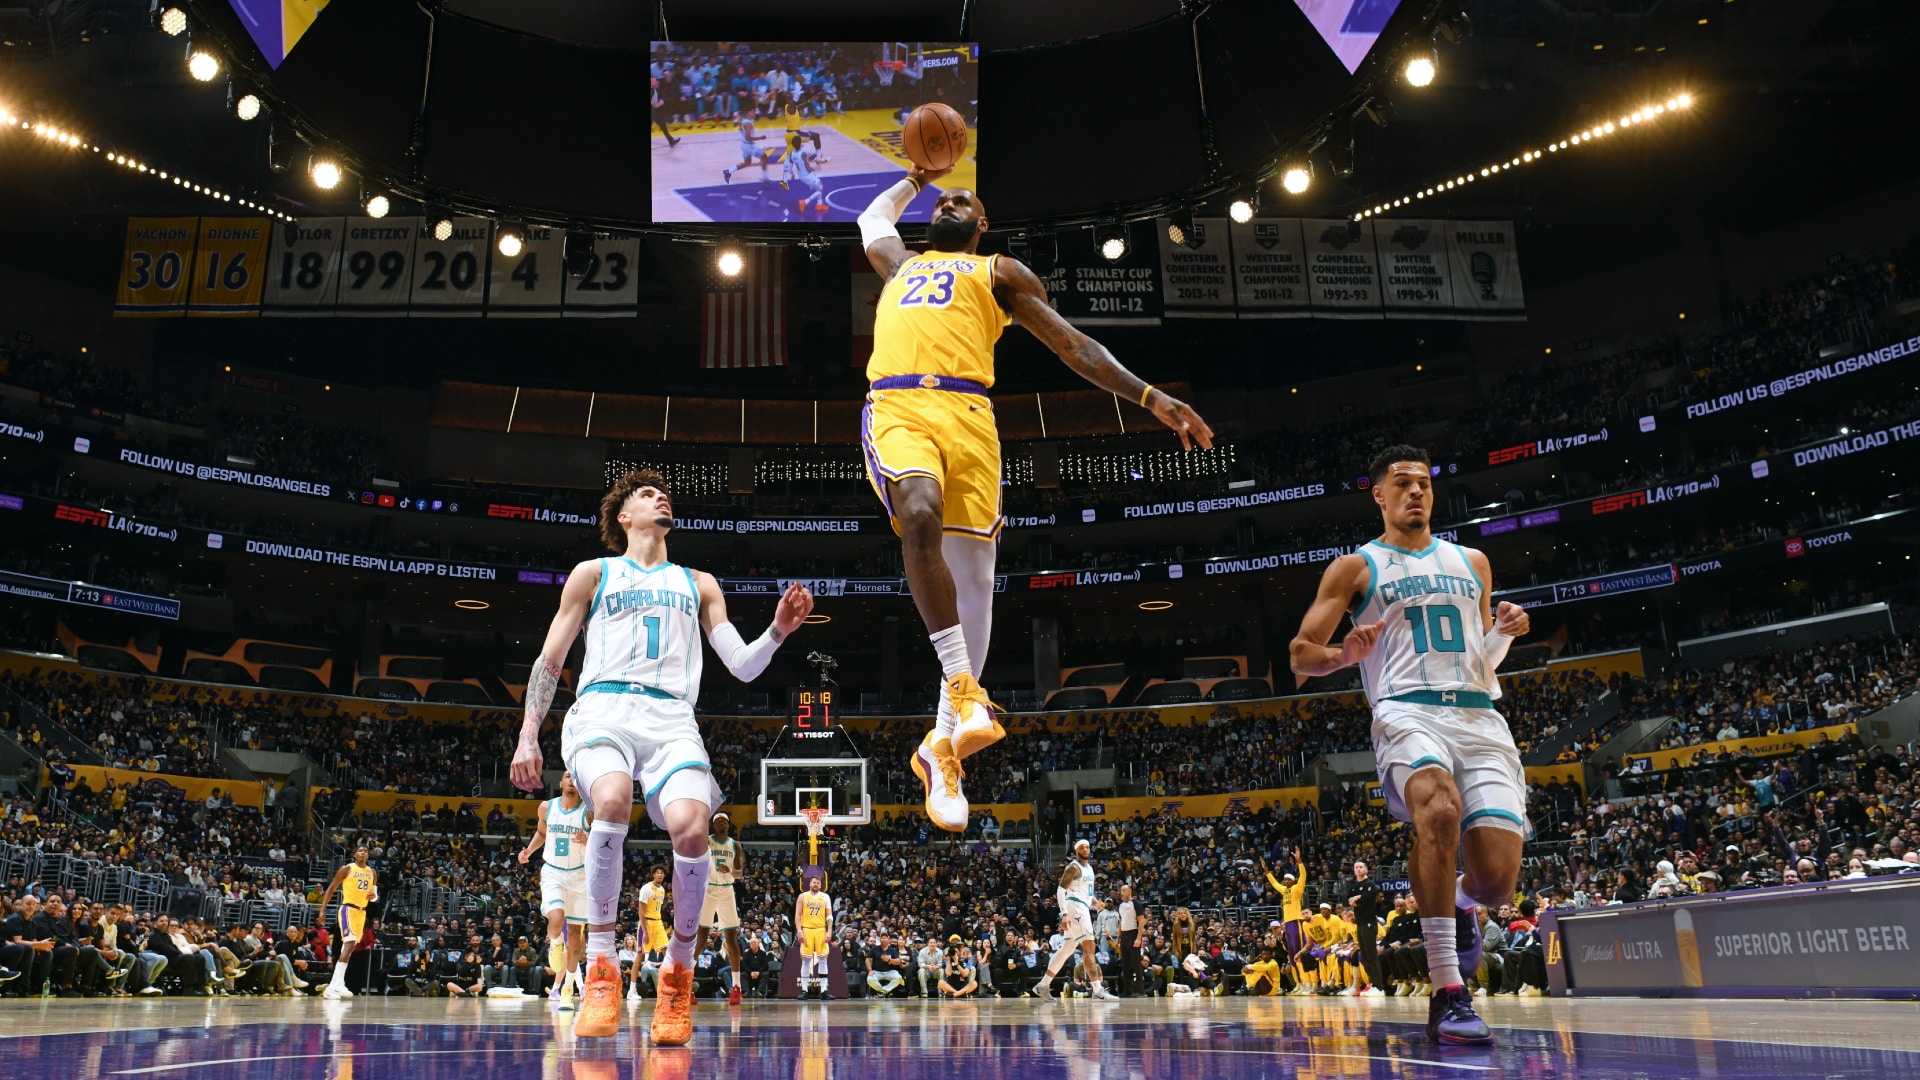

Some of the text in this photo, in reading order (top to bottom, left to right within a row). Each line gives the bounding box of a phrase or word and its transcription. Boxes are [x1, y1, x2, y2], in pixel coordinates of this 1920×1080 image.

[136, 228, 188, 240] VACHON
[208, 228, 260, 240] DIONNE
[298, 229, 332, 240] YLOR
[350, 228, 410, 240] GRETZKY
[526, 229, 550, 240] AKE
[1456, 232, 1504, 244] MILLER
[1171, 254, 1218, 263] WESTERN
[1246, 254, 1292, 263] WESTERN
[1316, 255, 1366, 264] CAMPBELL
[1394, 255, 1432, 264] SMYTHE
[127, 251, 182, 291] 30
[205, 252, 248, 291] 16
[280, 252, 323, 290] 18
[350, 251, 405, 290] 99
[420, 252, 477, 290] 20
[511, 252, 538, 290] 4
[1076, 267, 1152, 278] STANLEY CUP
[1166, 265, 1226, 274] CONFERENCE
[1240, 265, 1300, 274] CONFERENCE
[1312, 265, 1374, 274] CONFERENCE
[1394, 265, 1436, 274] DIVISION
[1076, 280, 1154, 292] CHAMPIONS
[1170, 276, 1225, 285] CHAMPIONS
[1244, 276, 1300, 285] CHAMPIONS
[1316, 276, 1372, 285] CHAMPIONS
[1388, 276, 1444, 286] CHAMPIONS
[899, 270, 956, 309] 23
[1178, 288, 1220, 300] 2013-14
[1253, 290, 1292, 300] 2011-12
[1323, 289, 1368, 300] 1992-93
[1396, 290, 1438, 300] 1990-91
[1089, 298, 1144, 312] 2011-12
[1687, 390, 1744, 419] FOLLOW
[1746, 384, 1768, 402] US
[1794, 420, 1920, 467] DOWNLOAD THE
[120, 448, 330, 497] FOLLOW US @ESPNLOSANGELES
[1124, 484, 1325, 518] FOLLOW US @ESPNLOSANGELES
[672, 518, 859, 534] OLLOW US @ESPNLOSANGELES
[1806, 532, 1852, 549] TOYOTA
[246, 540, 496, 580] DOWNLOAD THE ESPN LA APP & LISTEN
[1205, 554, 1278, 575] DOWNLOAD
[1281, 552, 1306, 566] THE
[1309, 547, 1345, 563] ESPN
[1681, 560, 1722, 576] TOYOTA
[10, 586, 54, 600] Anniversary
[75, 588, 100, 601] 7:13
[736, 583, 767, 592] Lakers
[854, 583, 892, 592] Hornets
[1380, 574, 1475, 606] CHARLOTTE
[1560, 586, 1586, 598] 7:13
[605, 589, 693, 617] CHARLOTTE
[1404, 604, 1466, 654] 10
[642, 616, 660, 660] 1
[1505, 666, 1597, 689] AKERS
[800, 692, 831, 704] 10:18
[798, 705, 829, 728] 21
[1086, 806, 1102, 814] 116
[555, 838, 570, 856] 8
[252, 866, 284, 874] XPRESS
[716, 858, 726, 872] 5
[358, 880, 368, 890] 28
[1381, 882, 1394, 890] 17x
[809, 906, 820, 916] 77
[1546, 931, 1562, 964] LA
[1580, 926, 1911, 964] Michelob ULTRA SUPERIOR LIGHT BEER
